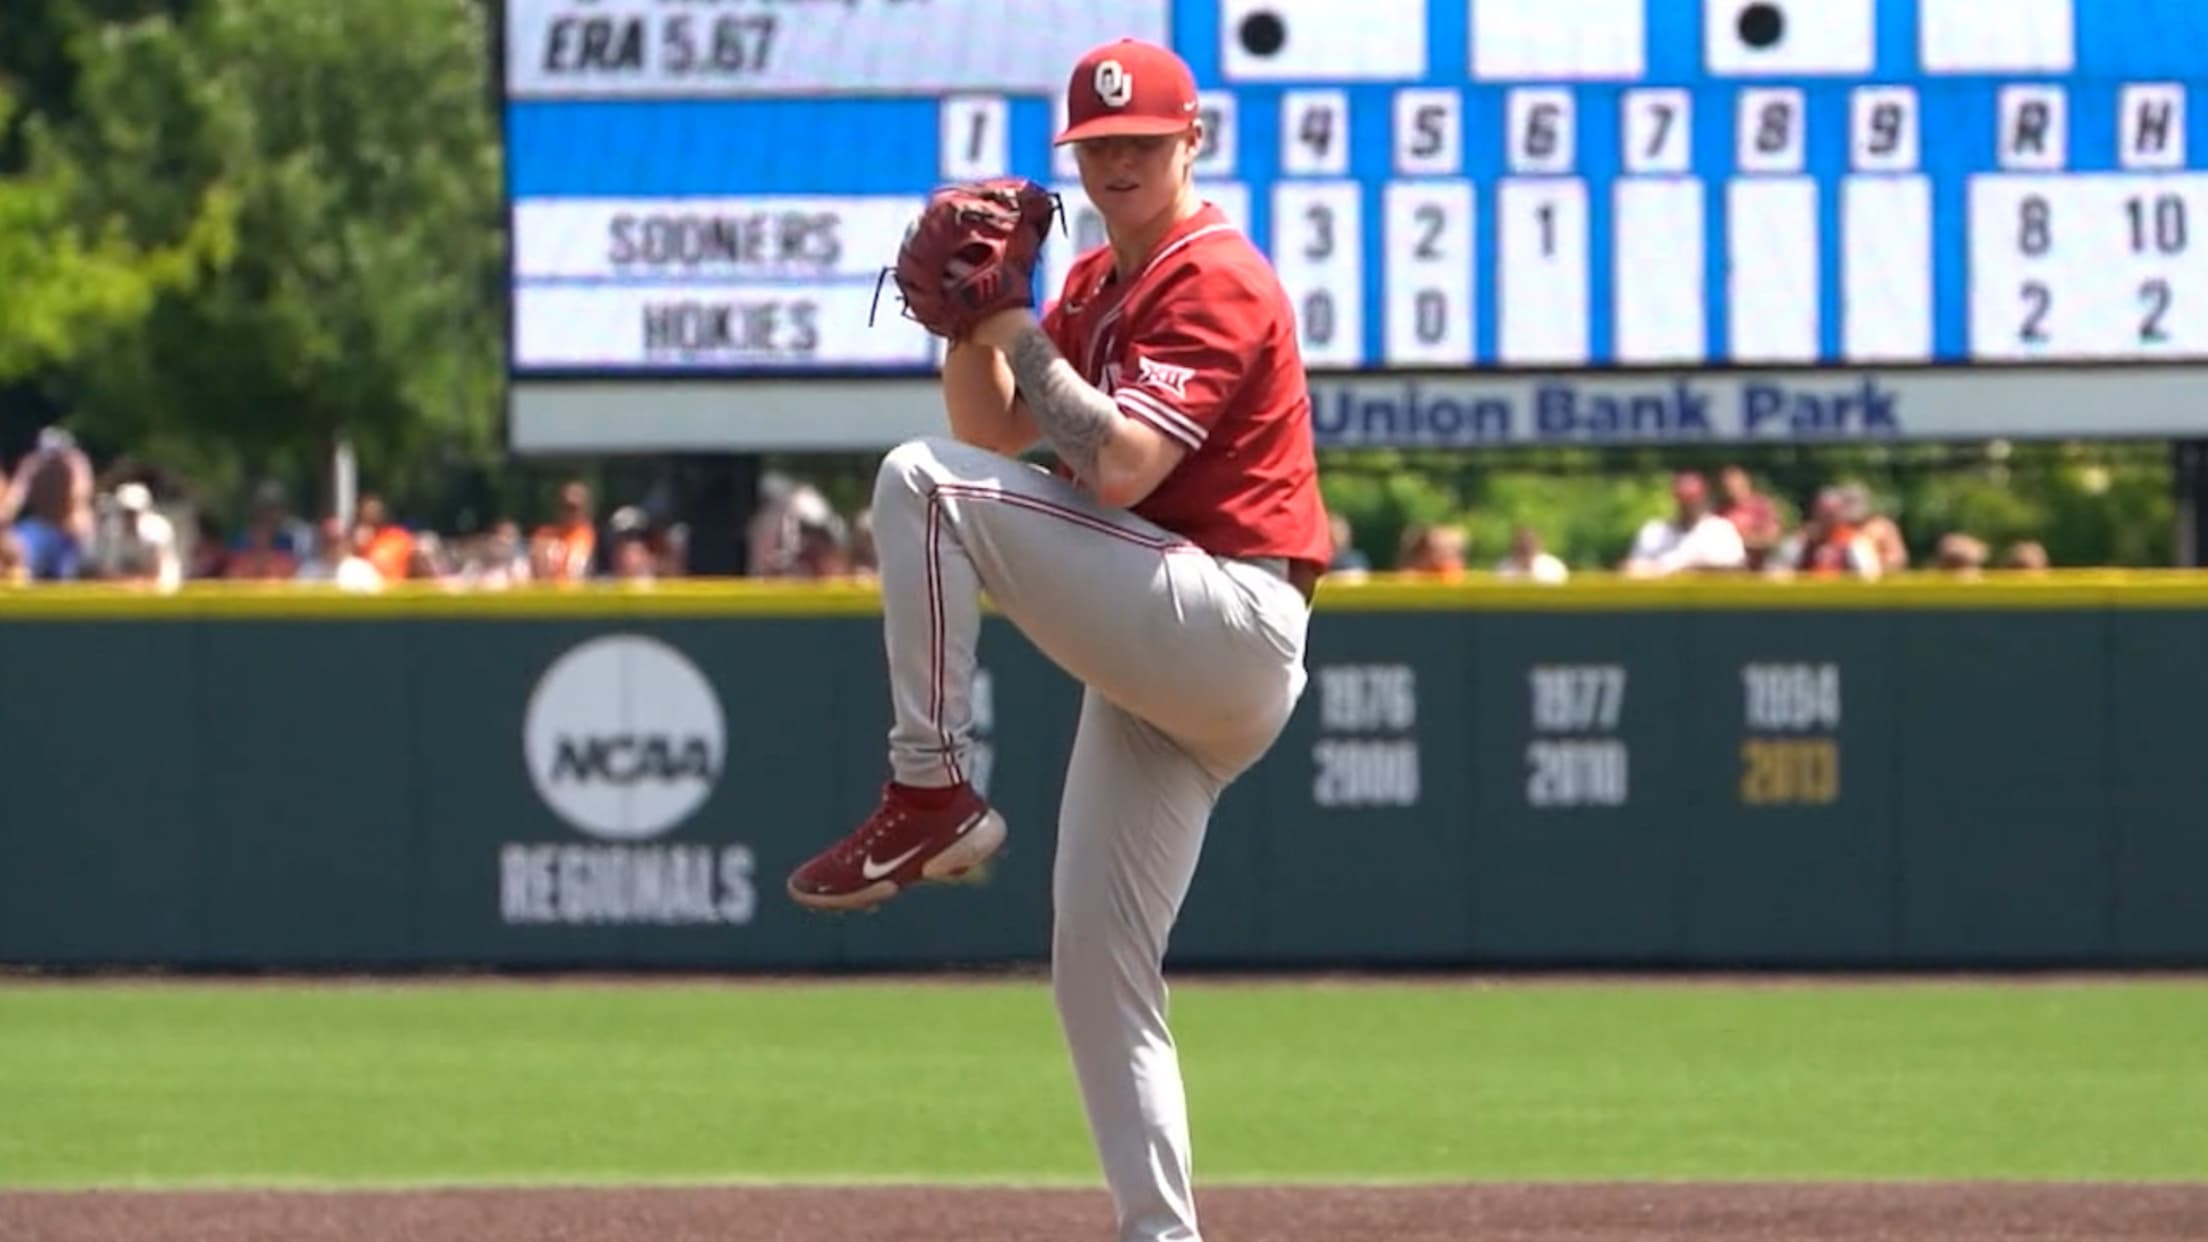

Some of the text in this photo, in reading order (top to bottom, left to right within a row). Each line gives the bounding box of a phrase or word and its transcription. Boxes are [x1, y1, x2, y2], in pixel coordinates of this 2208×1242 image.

[543, 14, 644, 73] ERA
[1094, 59, 1132, 107] OU
[1299, 105, 1334, 158] 4
[1410, 105, 1448, 158] 5
[1522, 104, 1559, 157] 6
[1645, 105, 1675, 158] 7
[1755, 102, 1791, 154] 8
[1868, 102, 1903, 156] 9
[2013, 100, 2050, 155] R
[2135, 100, 2172, 153] H
[608, 213, 842, 267] SOONERS
[1304, 204, 1335, 260] 3
[1412, 204, 1448, 261] 2
[1534, 203, 1556, 258] 1
[2018, 195, 2052, 256] 8
[2125, 193, 2187, 254] 10
[642, 301, 820, 352] HOKIES
[1304, 289, 1335, 346] 0
[1413, 290, 1448, 345] 0
[2018, 281, 2052, 342] 2
[2137, 277, 2173, 342] 2
[1314, 380, 1898, 435] Union Bank Park
[1320, 664, 1416, 731] 1976
[1529, 664, 1627, 731] 1977
[549, 734, 717, 786] NCAA
[500, 842, 756, 924] REGIONALS
